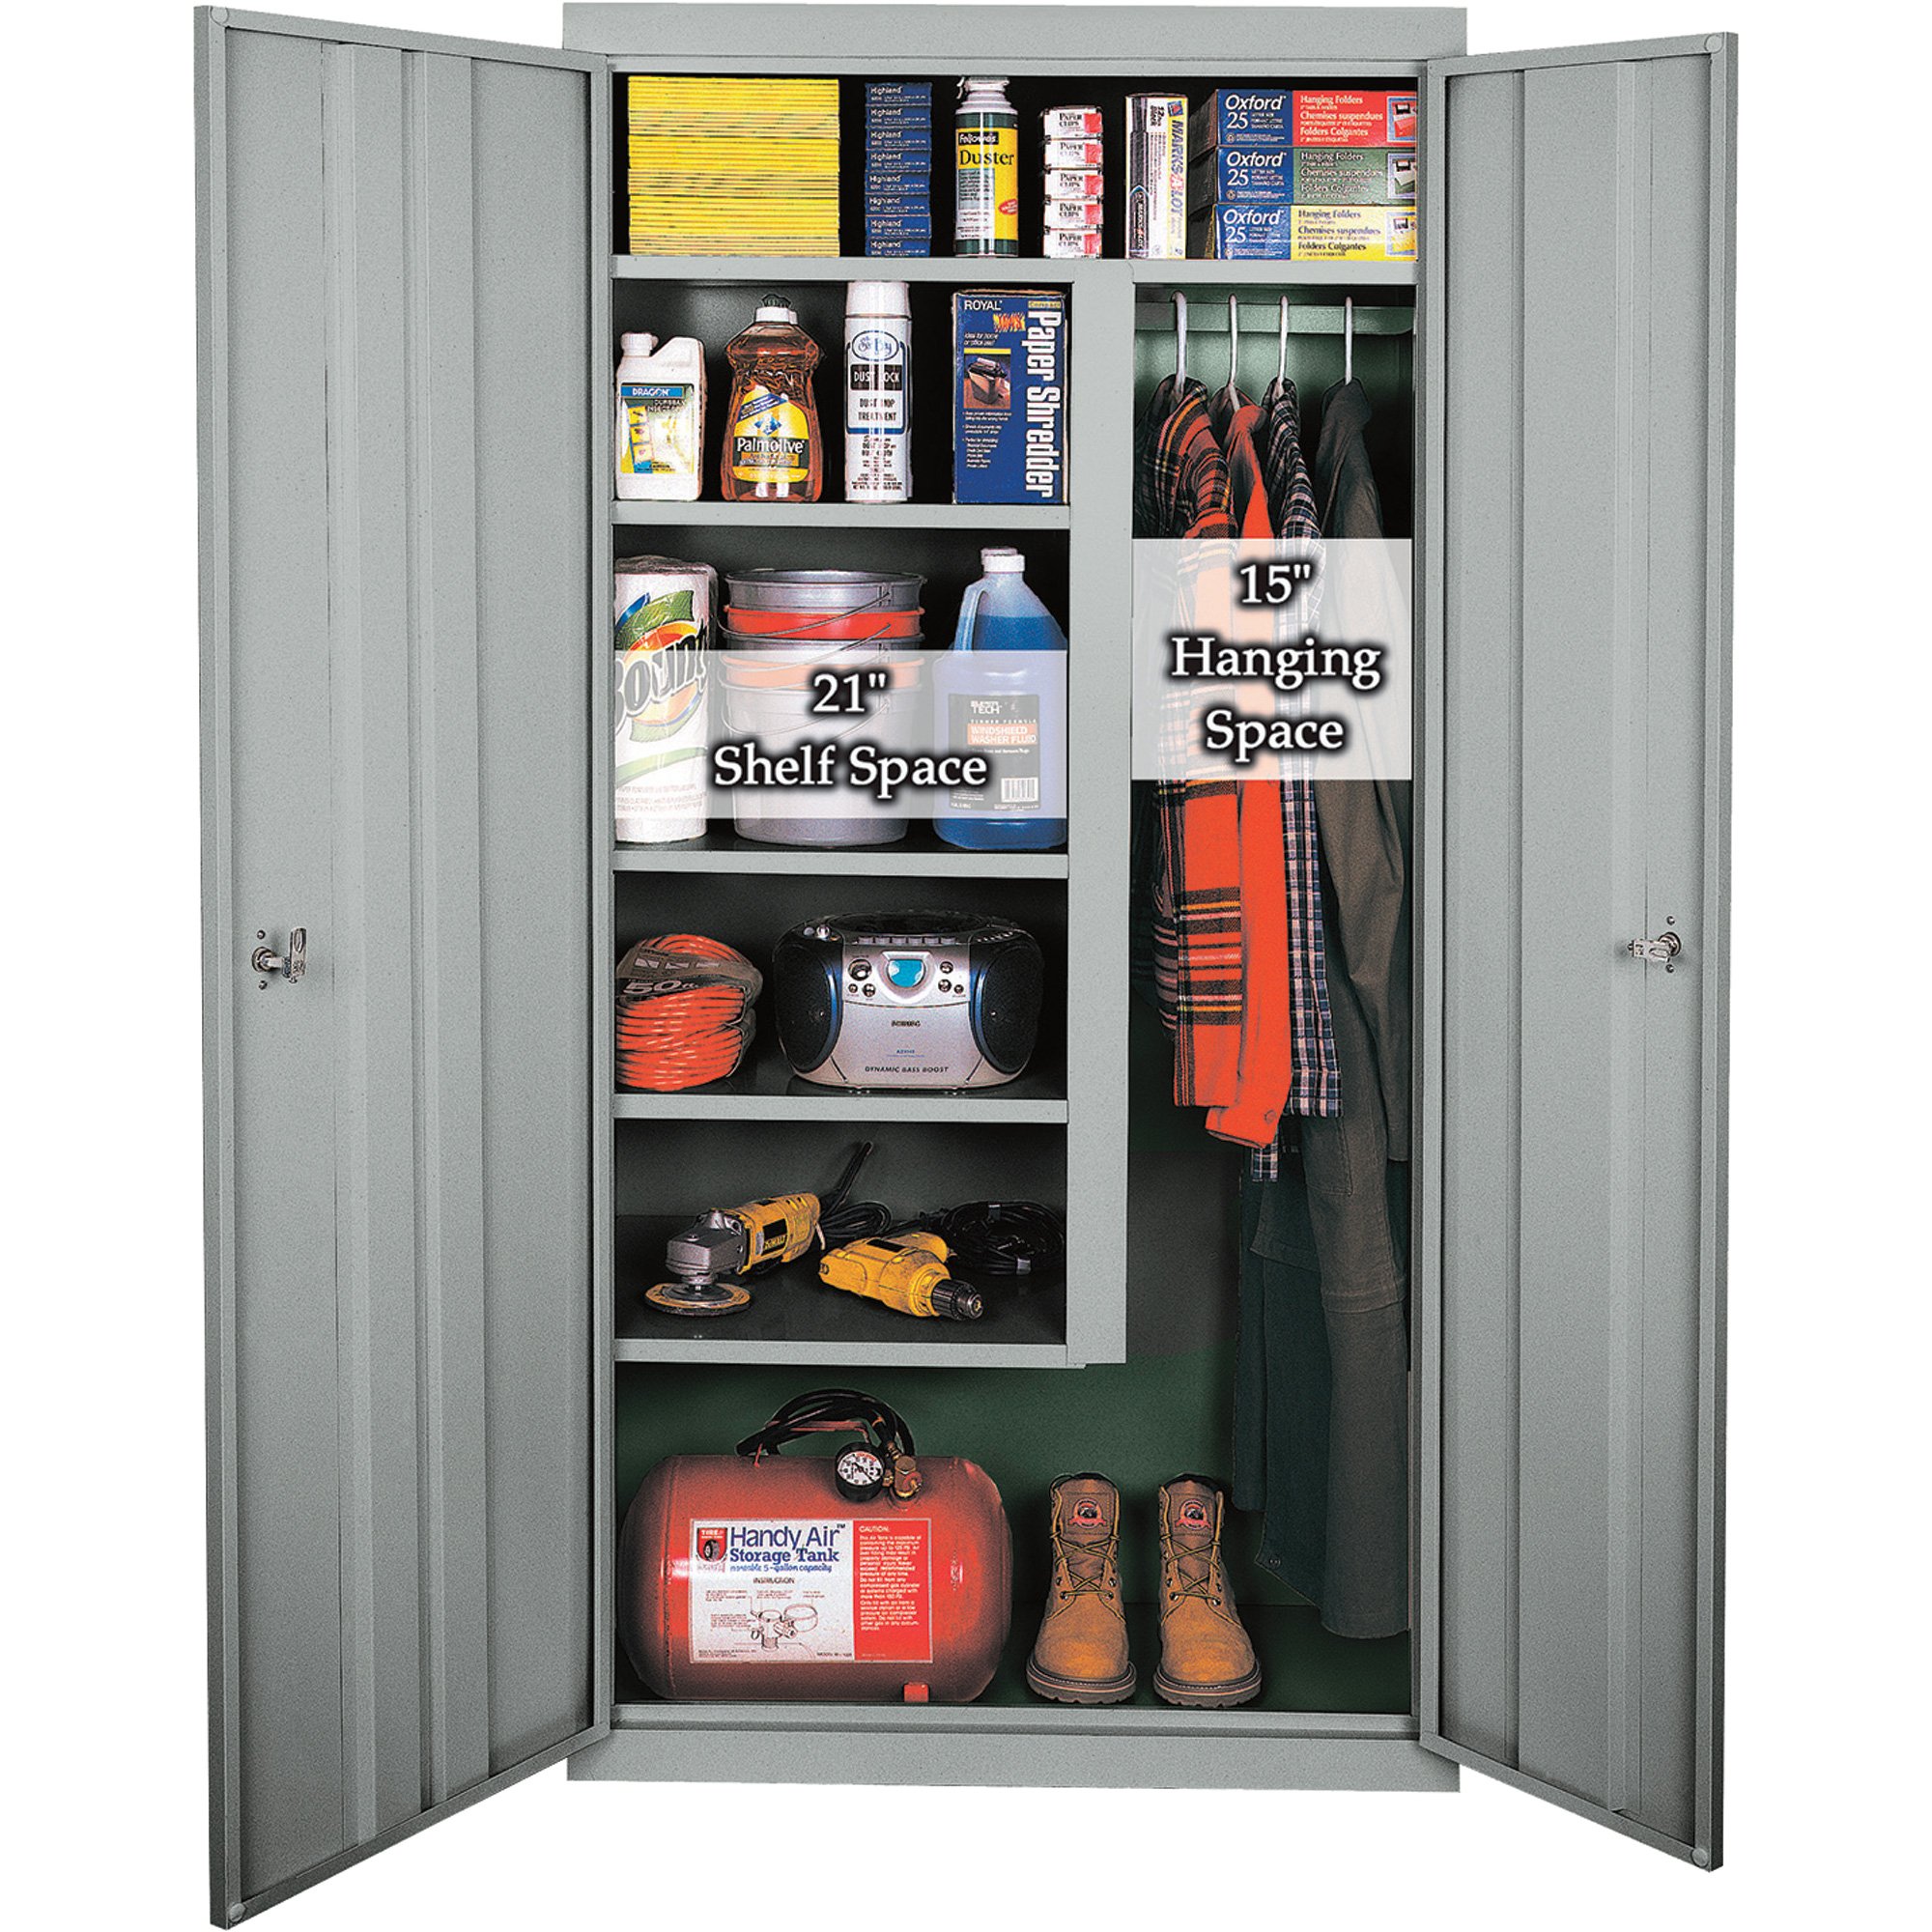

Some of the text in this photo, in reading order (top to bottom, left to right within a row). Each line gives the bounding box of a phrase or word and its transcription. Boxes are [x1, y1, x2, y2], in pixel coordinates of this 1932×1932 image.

[870, 86, 902, 95] Highland
[1225, 94, 1283, 110] Oxford
[1300, 95, 1363, 105] Hanging Folders
[870, 108, 902, 117] Highland
[1300, 111, 1383, 122] Chemises suspendues
[1227, 112, 1248, 129] 25
[1330, 128, 1369, 137] Colgantes
[870, 153, 902, 161] Highland
[959, 150, 1015, 165] Duster
[1227, 151, 1284, 167] Oxford
[1300, 152, 1364, 161] Hanging Folders
[1227, 169, 1249, 185] 25
[1300, 168, 1383, 179] Chemises suspendues
[869, 175, 901, 184] Highland
[1300, 184, 1369, 194] Folders Colgantes
[1223, 209, 1281, 225] Oxford
[1298, 210, 1361, 219] Hanging Folders
[870, 219, 902, 228] Highland
[1225, 226, 1246, 243] 25
[1298, 225, 1380, 236] Chemises suspendues
[870, 241, 902, 249] Highland
[1298, 242, 1366, 252] Folders Colgantes
[964, 299, 1001, 310] ROYAL
[1022, 311, 1062, 382] Paper
[854, 371, 899, 383] DUST OCK
[632, 387, 670, 397] DRAGON
[858, 412, 896, 421] TREATMENT
[736, 438, 804, 453] Palmolive
[1026, 385, 1061, 497] Shredder
[972, 706, 1001, 715] TECH
[971, 725, 1028, 734] WINDSHIELD
[623, 980, 682, 994] 50
[729, 1525, 802, 1550] Handy
[729, 1548, 791, 1565] Storage
[796, 1548, 839, 1562] Tank
[799, 1563, 833, 1573] capacity
